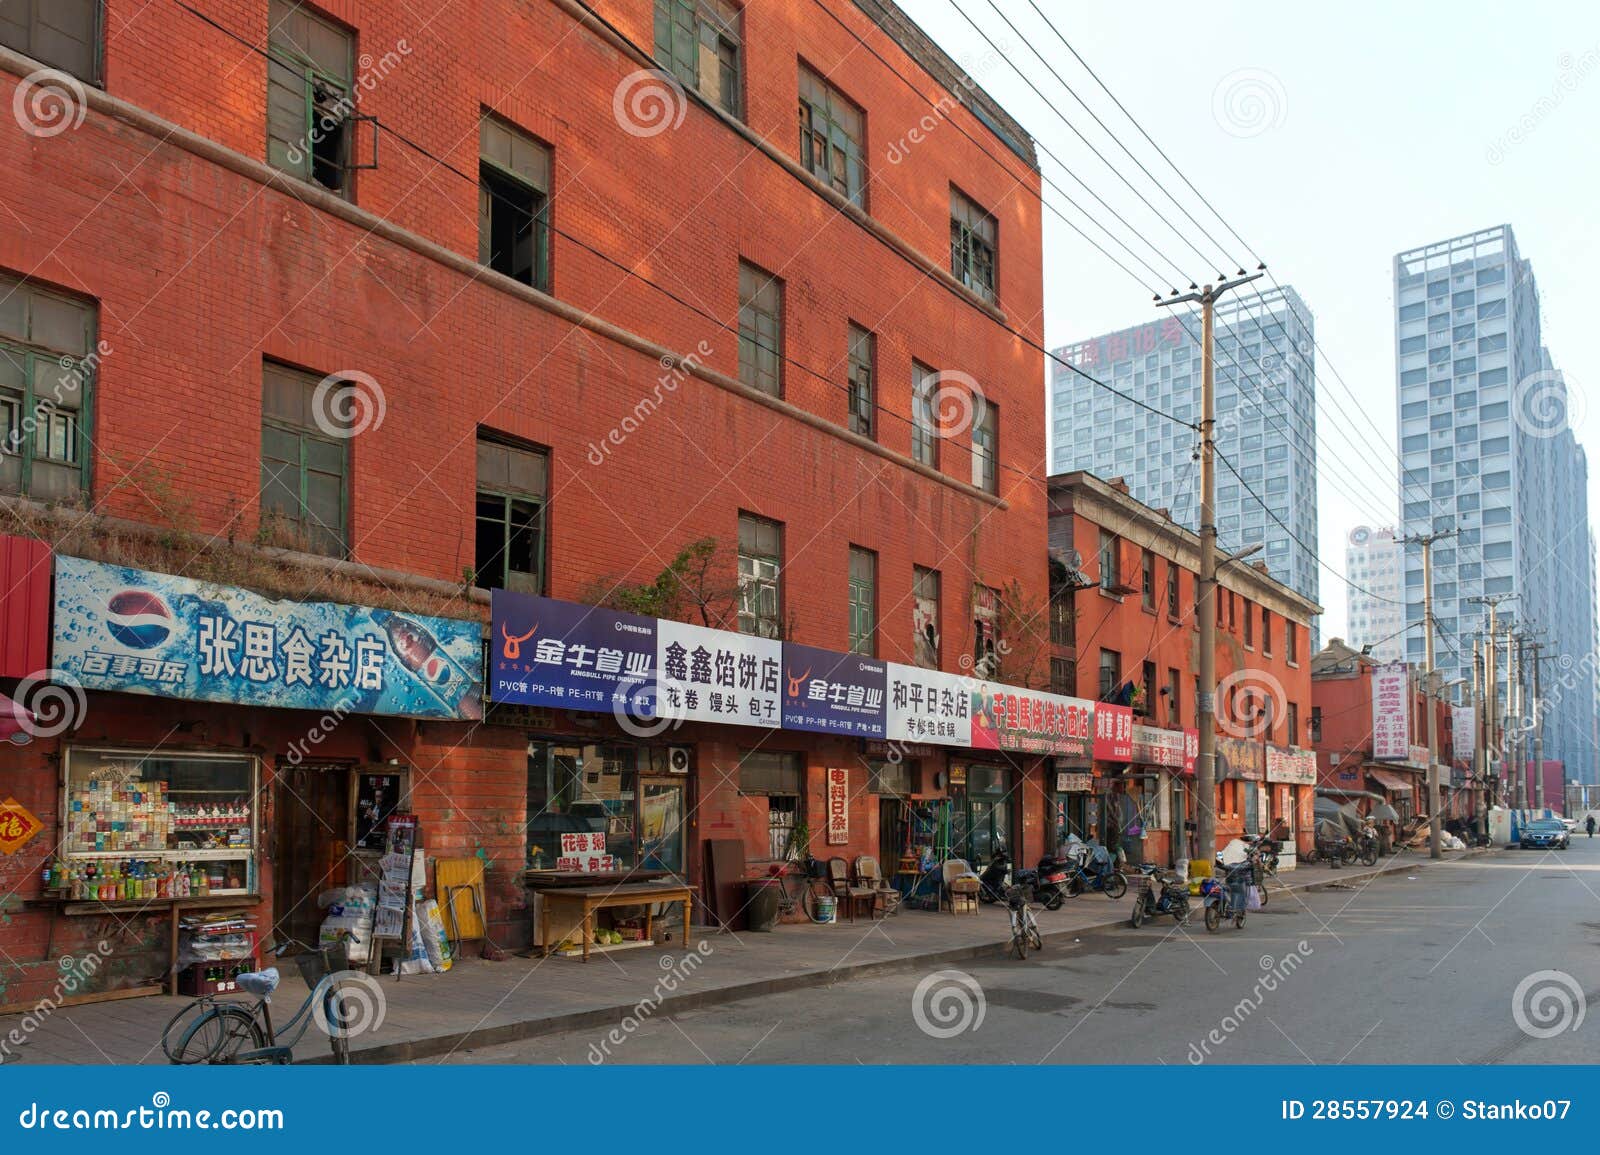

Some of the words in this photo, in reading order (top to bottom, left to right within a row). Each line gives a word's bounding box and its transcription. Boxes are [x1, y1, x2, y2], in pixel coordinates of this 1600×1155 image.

[82, 651, 187, 684] 百事可乐
[200, 617, 384, 690] 张思食杂店
[534, 638, 652, 677] 金牛管业
[665, 641, 779, 693] 鑫鑫馅饼店
[570, 669, 602, 679] KINGBULL
[499, 680, 528, 693] PVC管
[532, 683, 565, 697] PP-R管
[568, 688, 604, 701] PE-RT管
[667, 687, 699, 710] 花卷
[709, 692, 739, 714] 馒头
[749, 697, 776, 718] 包子
[808, 679, 882, 708] 金牛管业
[893, 680, 968, 719] 和平日杂店
[785, 714, 804, 725] PVC管
[806, 716, 827, 727] PP-R管
[829, 719, 852, 730] PE-RT管
[906, 717, 956, 737] 专修电饭锅
[831, 768, 846, 830] 电料日杂
[563, 834, 589, 852] 花卷
[588, 856, 612, 872] 包子
